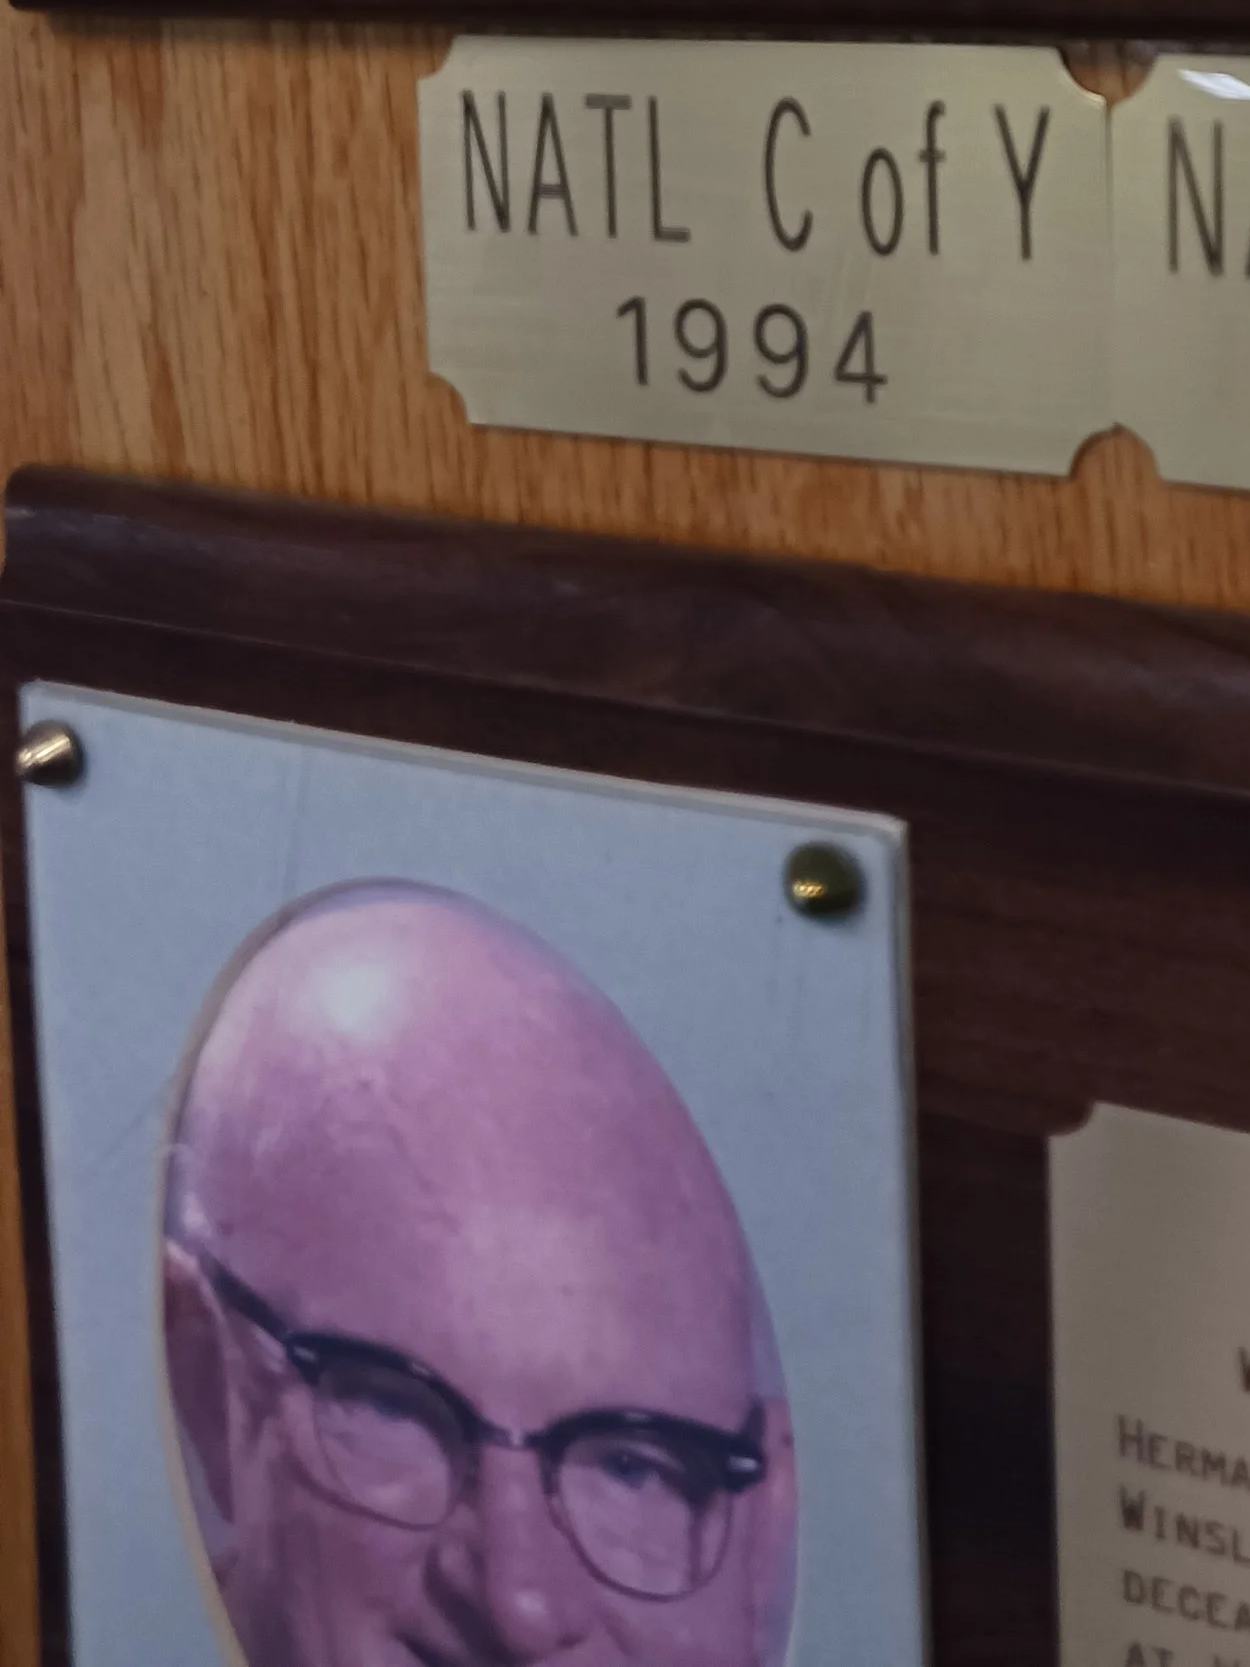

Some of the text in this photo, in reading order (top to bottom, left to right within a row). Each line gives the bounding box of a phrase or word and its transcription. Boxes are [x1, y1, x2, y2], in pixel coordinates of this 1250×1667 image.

[459, 89, 1050, 262] NATL C of Y
[614, 294, 889, 406] 1994
